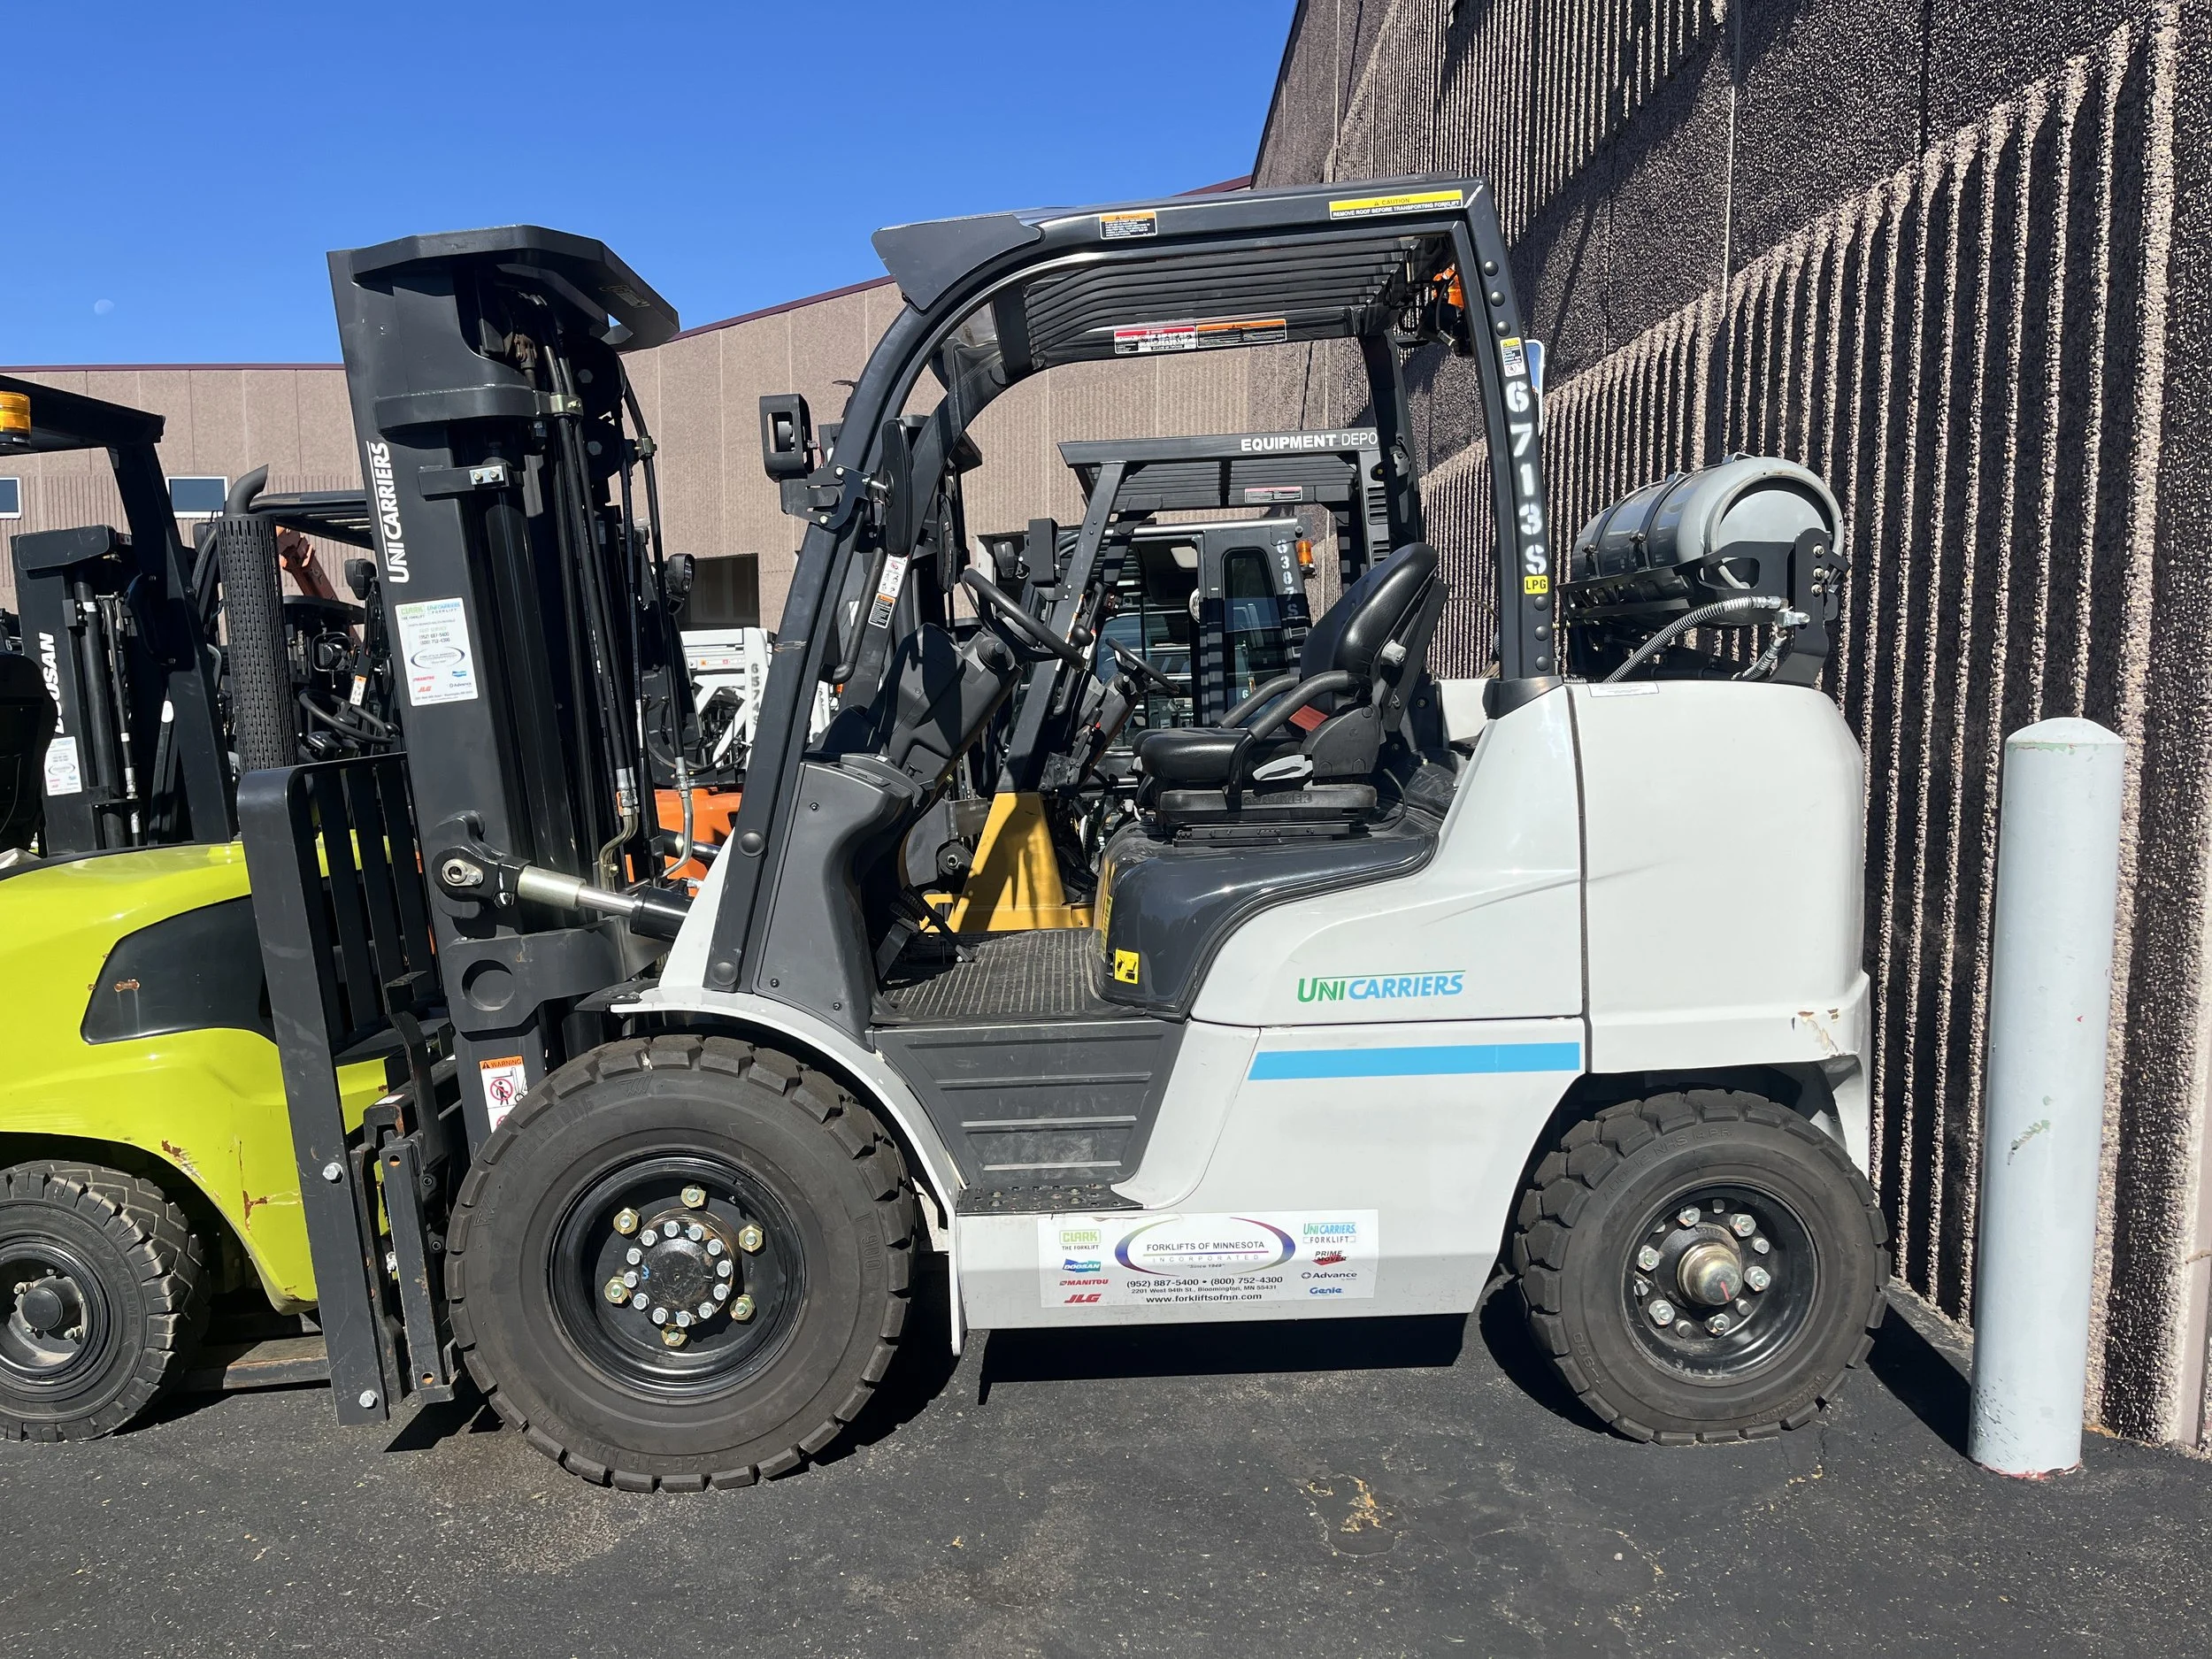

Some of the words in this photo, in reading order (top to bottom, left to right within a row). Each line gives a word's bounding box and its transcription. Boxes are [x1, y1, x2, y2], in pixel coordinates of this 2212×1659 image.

[1381, 197, 1410, 206] CAUTION
[1393, 204, 1434, 212] TRANSPORTING
[1240, 434, 1337, 452] EQUIPMENT
[1506, 380, 1548, 575] 6713S
[367, 442, 410, 584] UNICARRIERS
[1525, 579, 1547, 591] LPG
[1297, 972, 1464, 1002] UNICARRIERS
[490, 1058, 522, 1068] WARNING
[1303, 1222, 1356, 1235] UNICARRIERS
[1063, 1232, 1098, 1242] CLARK
[1310, 1235, 1349, 1244] FORKLIFT
[1212, 1240, 1265, 1249] MINNESOTA
[1153, 1254, 1259, 1263] INCORPORATED
[1064, 1262, 1101, 1271] DOOSAN
[1154, 1279, 1199, 1287] 887-5400
[1210, 1277, 1235, 1286] (800)
[1064, 1293, 1102, 1304] JLG
[1146, 1294, 1263, 1303] www.forkliftsofmn.com
